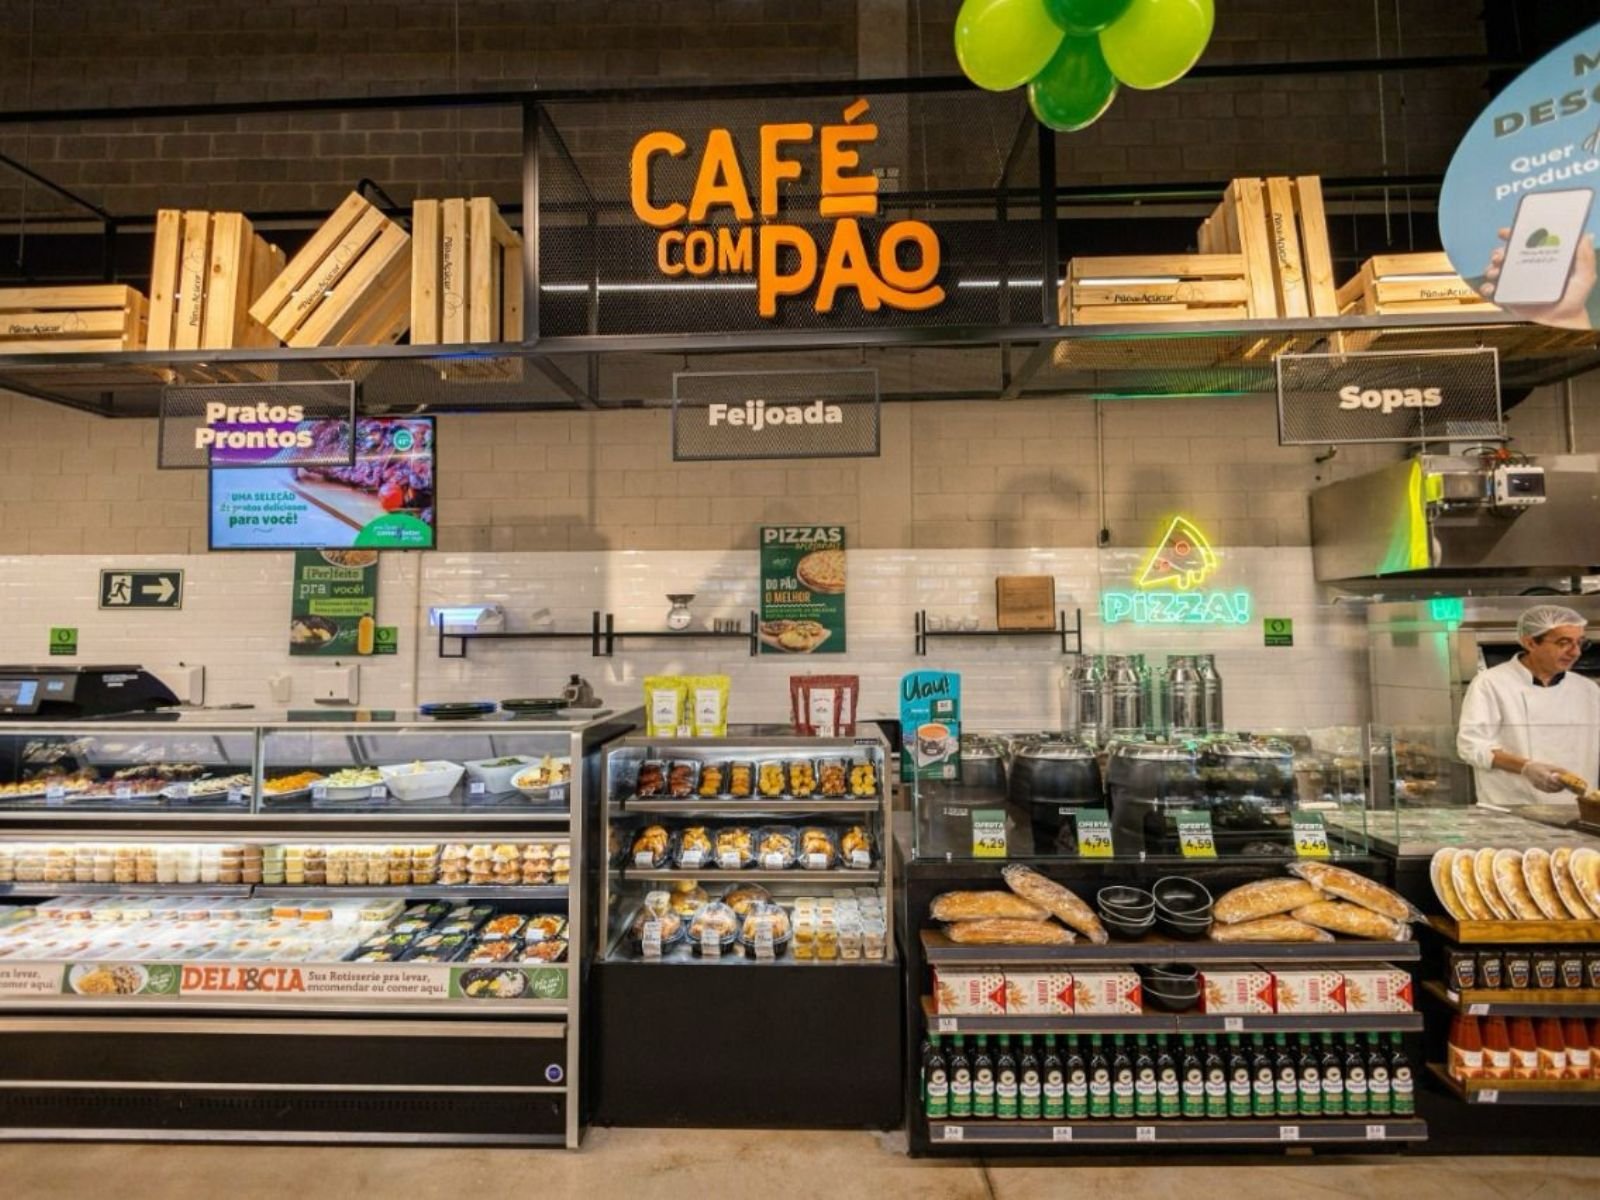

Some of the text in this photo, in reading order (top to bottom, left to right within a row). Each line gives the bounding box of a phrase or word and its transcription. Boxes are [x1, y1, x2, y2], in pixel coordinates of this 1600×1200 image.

[1494, 83, 1600, 138] DES
[631, 98, 879, 229] CAFÉ
[1510, 144, 1574, 173] Quer
[658, 227, 753, 277] COM
[1339, 385, 1443, 413] Sopas
[205, 402, 304, 424] Pratos
[708, 399, 843, 431] Feijoada
[194, 427, 314, 449] Prontos
[229, 512, 298, 528] para você!
[764, 527, 842, 544] PIZZAS
[300, 583, 326, 599] pra
[903, 675, 950, 701] Uau!
[307, 982, 369, 993] encomendar
